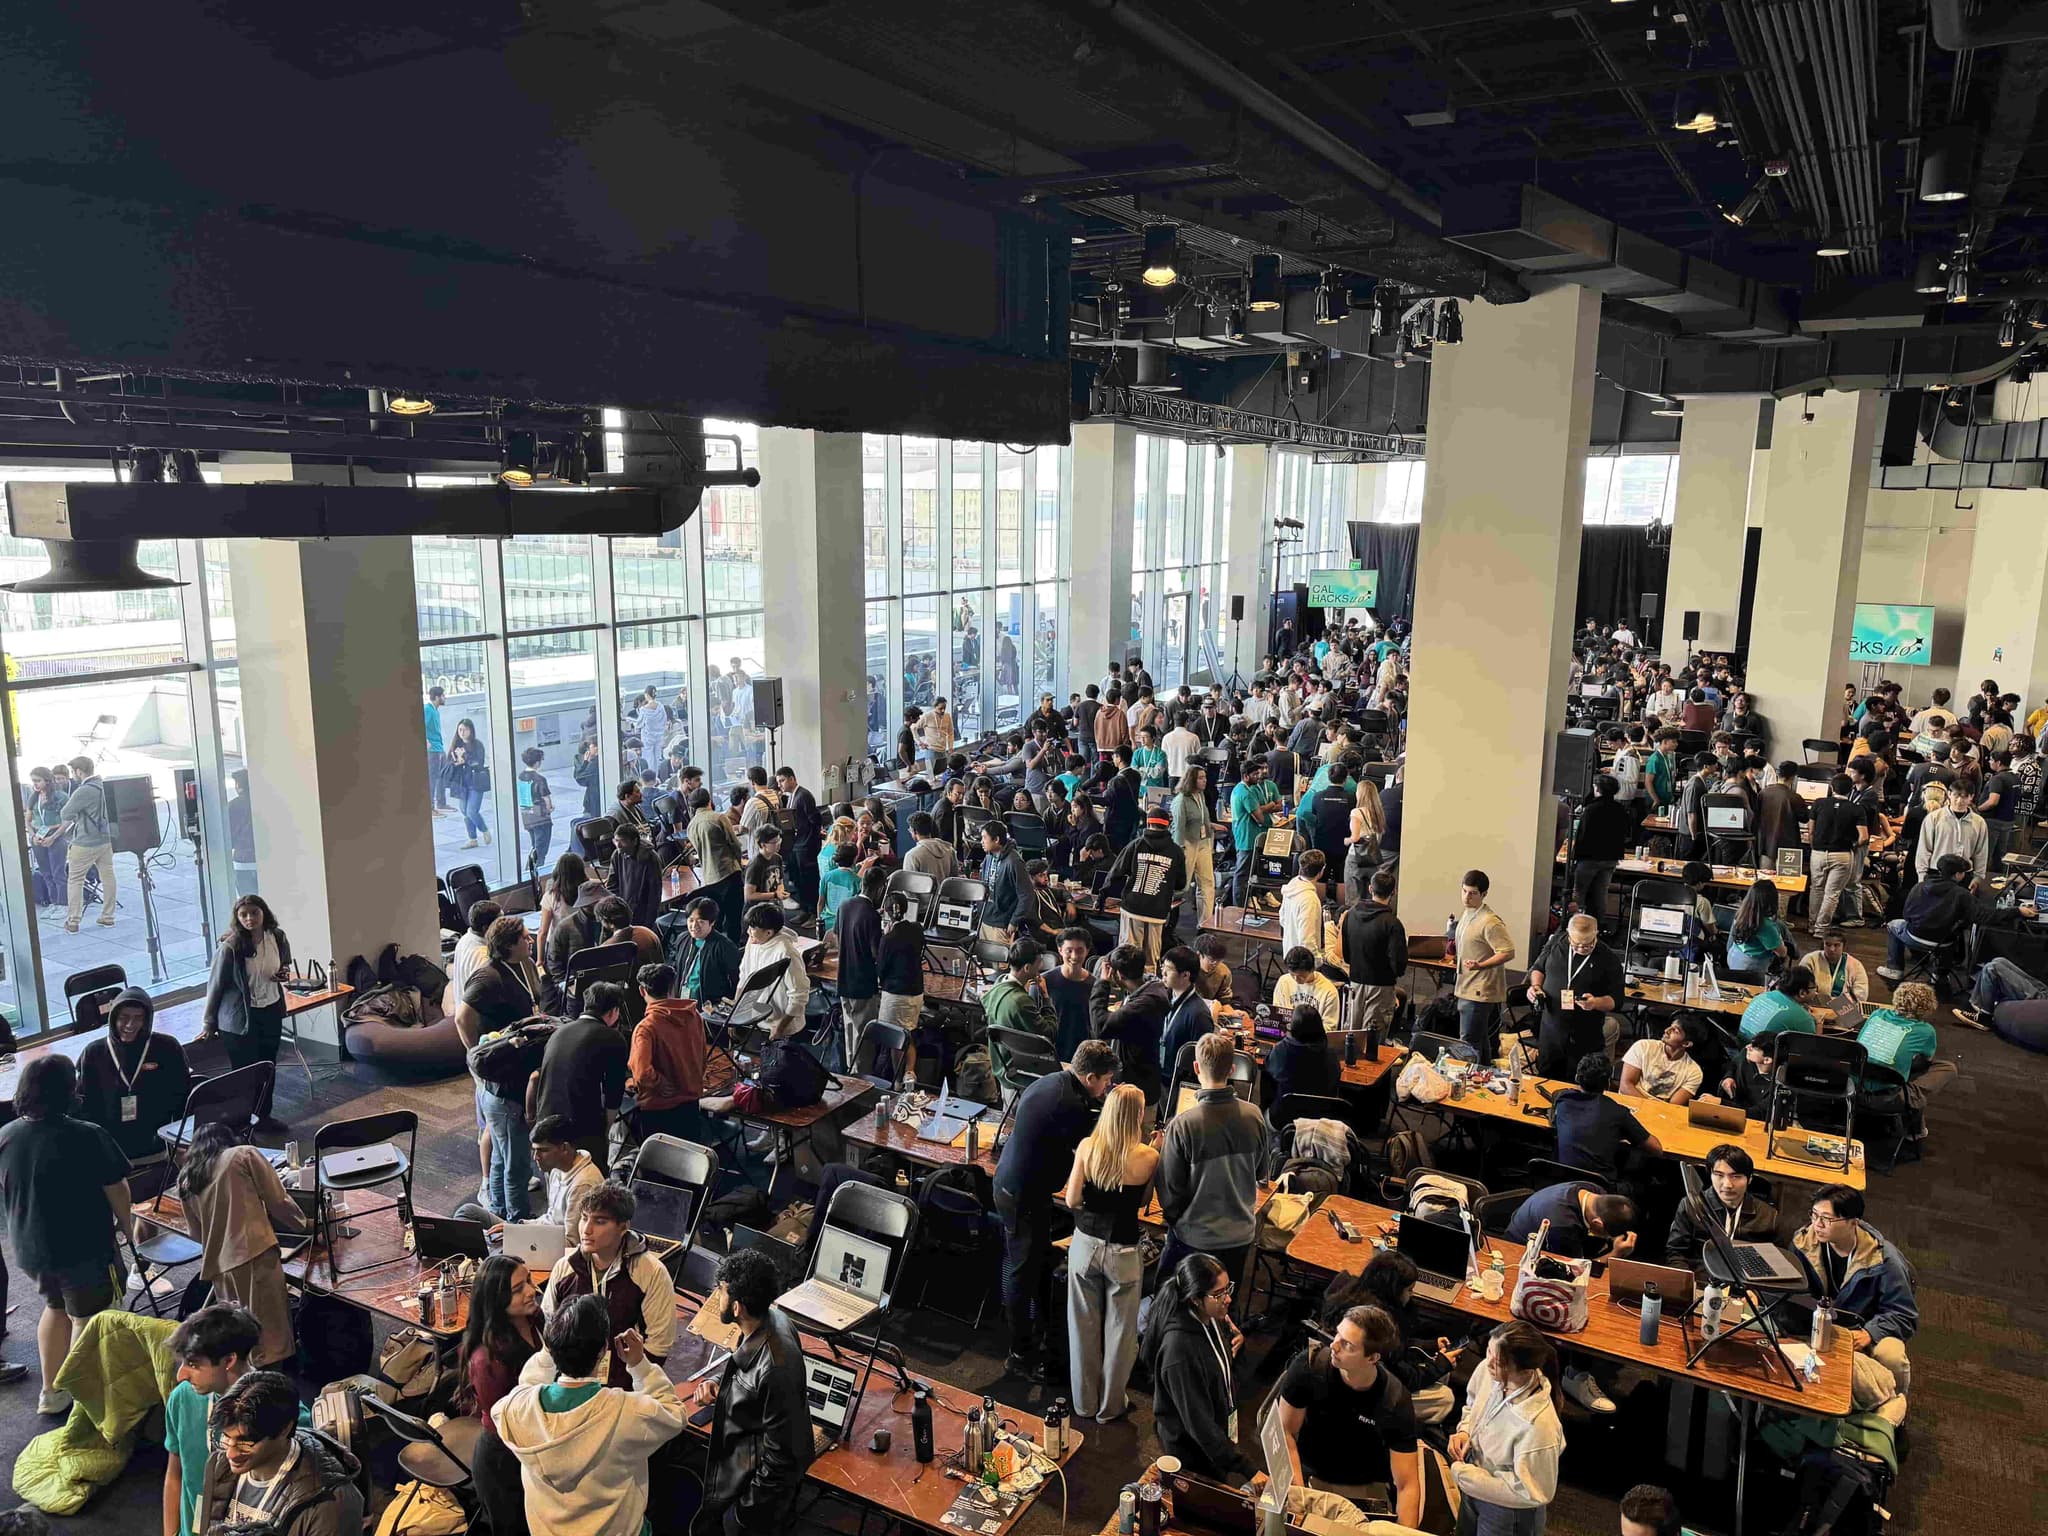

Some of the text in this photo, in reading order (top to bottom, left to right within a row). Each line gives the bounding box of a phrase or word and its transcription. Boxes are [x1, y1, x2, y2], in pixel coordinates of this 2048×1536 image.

[1312, 584, 1334, 594] CAL
[1311, 594, 1349, 603] HACKS
[1784, 855, 1795, 863] 27
